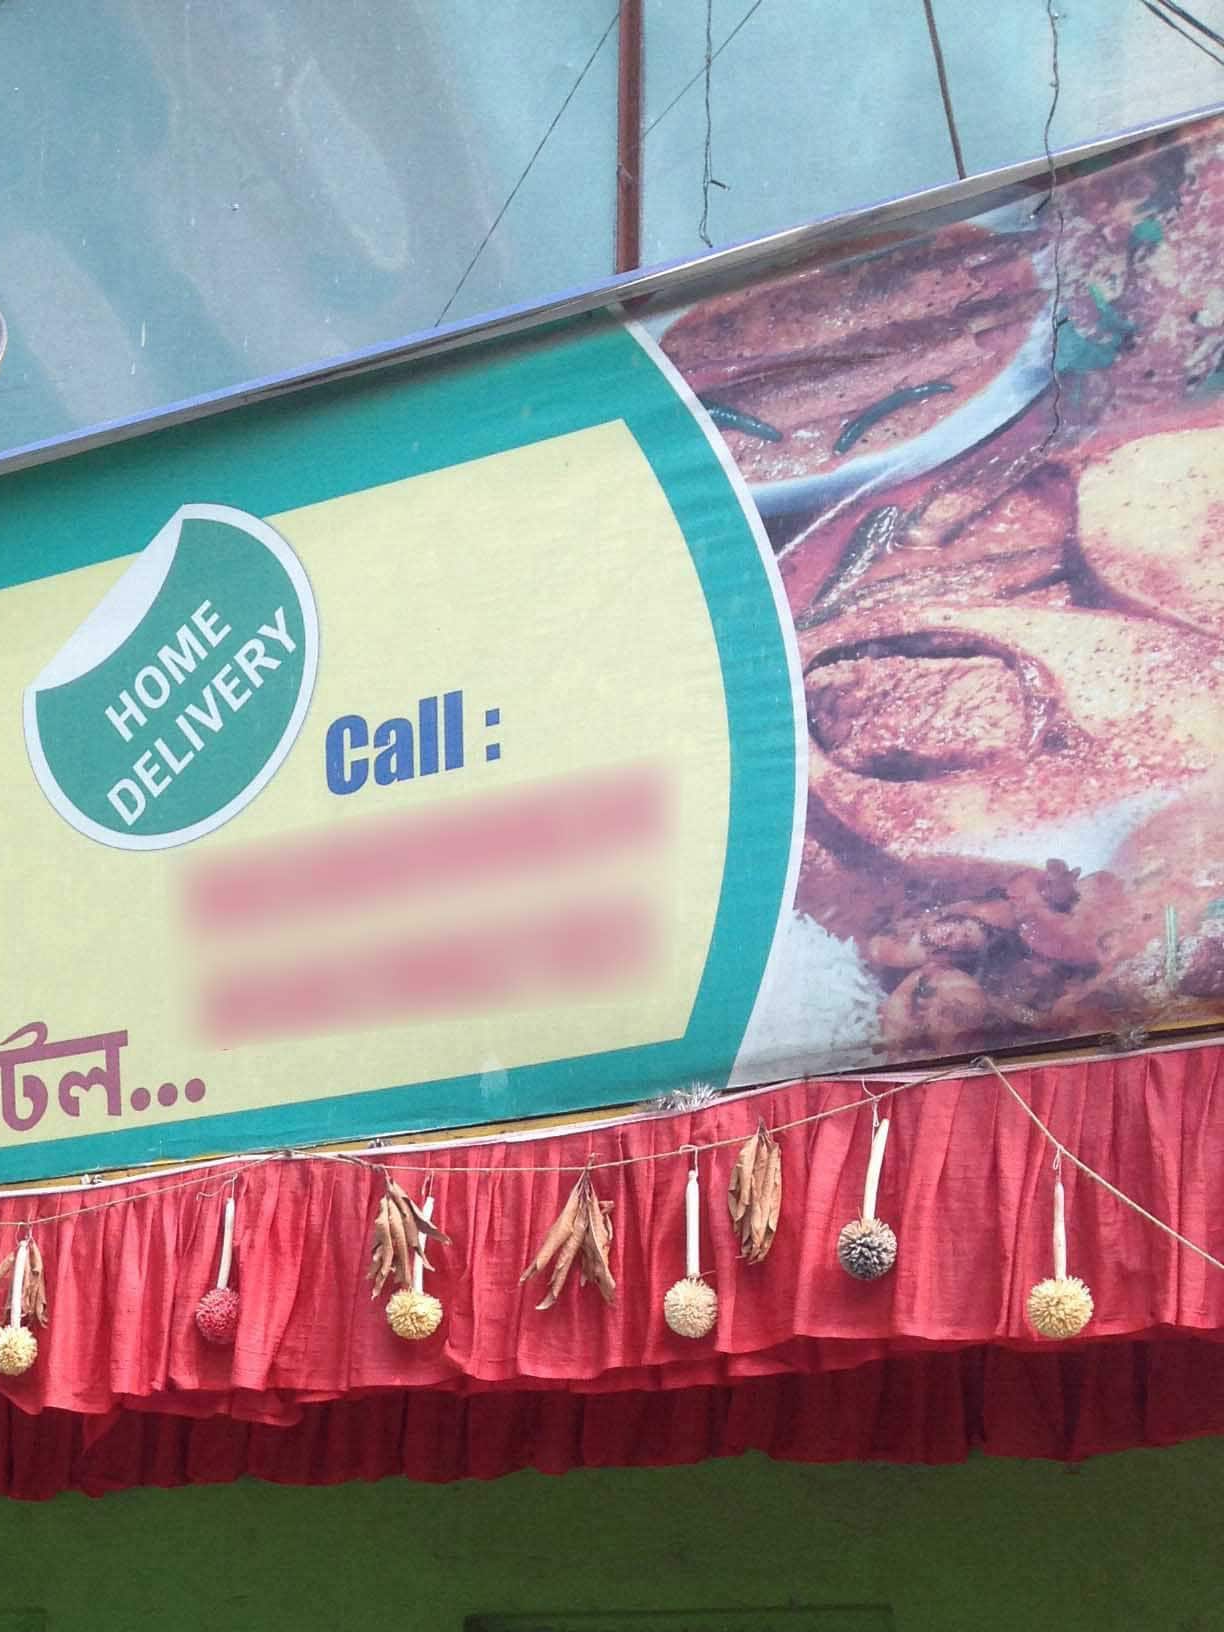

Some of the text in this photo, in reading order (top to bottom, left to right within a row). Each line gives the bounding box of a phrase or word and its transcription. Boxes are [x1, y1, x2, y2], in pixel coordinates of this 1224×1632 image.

[104, 600, 231, 742] HOME
[106, 607, 298, 826] DELIVERY
[324, 690, 464, 796] Call
